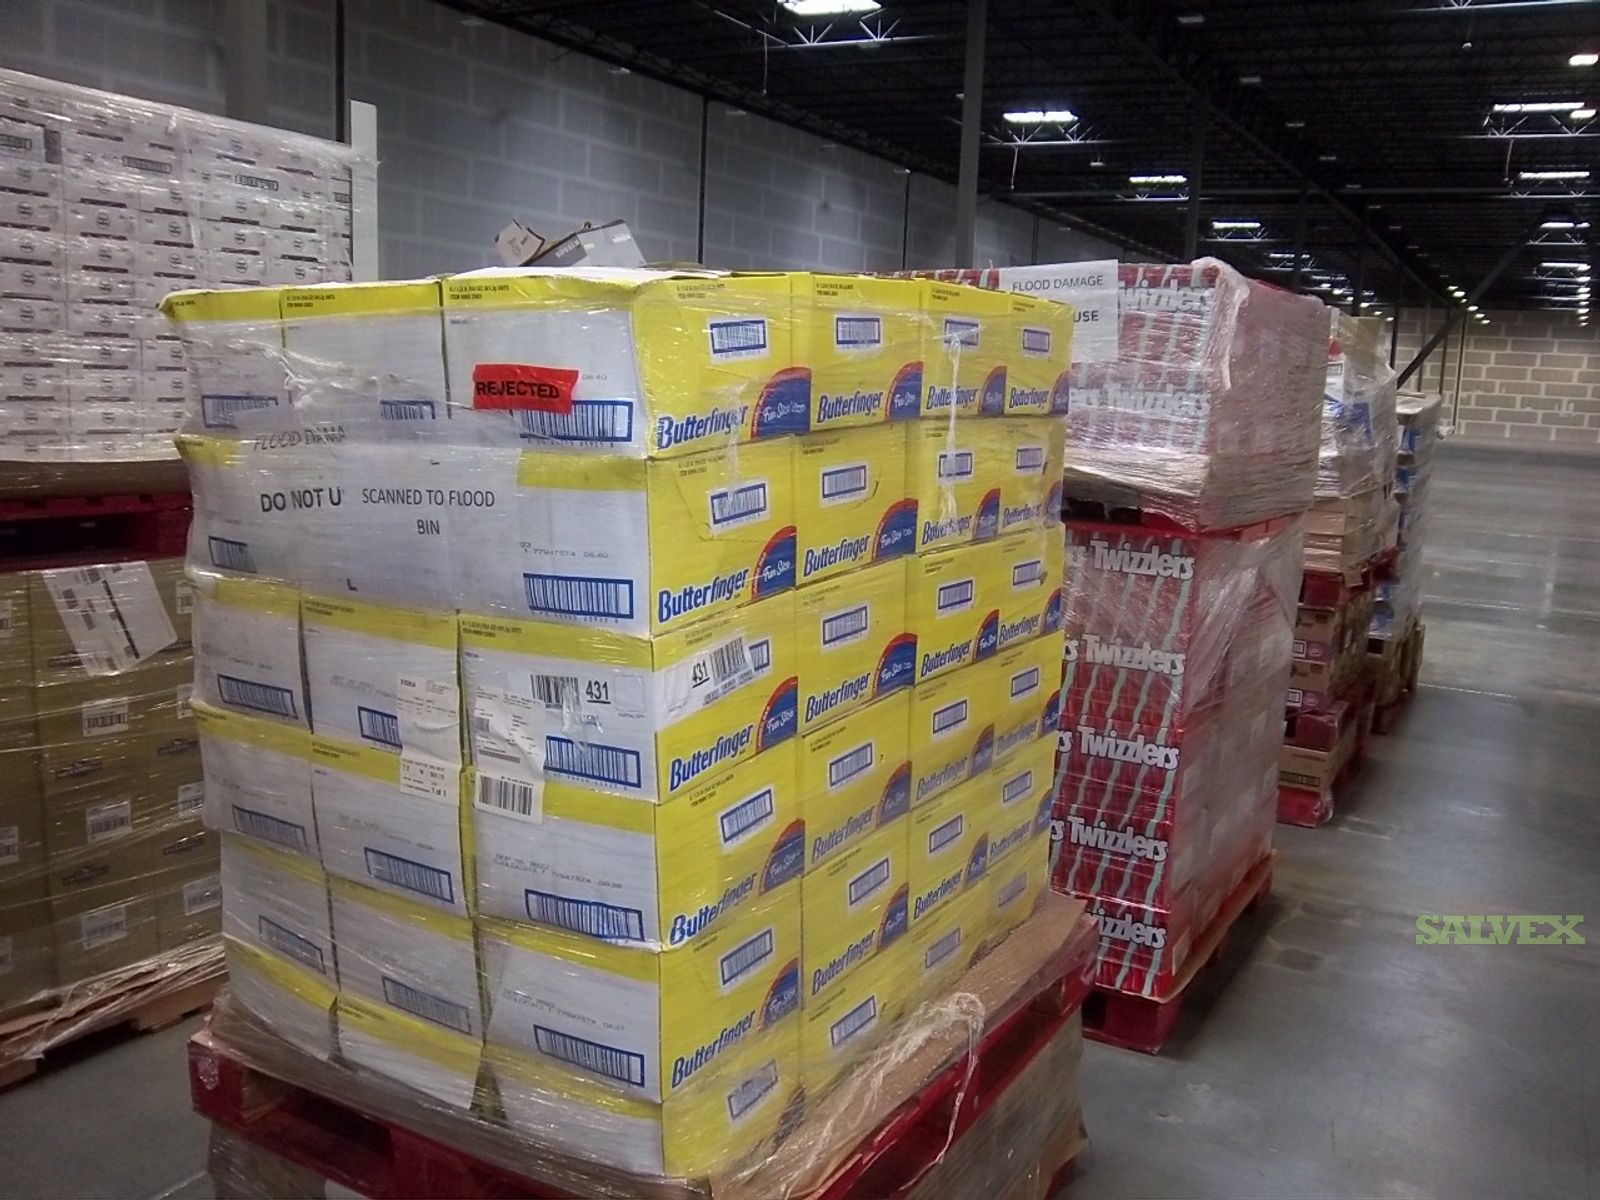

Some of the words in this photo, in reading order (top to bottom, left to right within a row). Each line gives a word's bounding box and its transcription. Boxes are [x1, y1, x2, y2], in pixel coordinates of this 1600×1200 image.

[1012, 279, 1050, 292] FLOOD
[1053, 275, 1104, 289] DAMAGE
[476, 380, 560, 399] REJECTED
[816, 391, 884, 424] Butterfinger
[1009, 386, 1049, 409] Butterfinger
[253, 430, 301, 450] FLOOD
[656, 404, 749, 449] Butterfinger
[260, 493, 286, 512] DO
[291, 488, 324, 509] NOT
[361, 488, 423, 506] SCANNED
[426, 489, 444, 506] TO
[448, 490, 495, 507] FLOOD
[416, 519, 440, 536] BIN
[762, 565, 777, 582] Fun
[803, 534, 870, 577] Butterfinger
[1090, 539, 1196, 580] Twizzlers
[658, 568, 749, 624] Butterfinger
[691, 659, 709, 683] 431
[920, 638, 973, 678] Butterfinger
[1082, 632, 1187, 677] Twizzlers
[586, 681, 609, 700] 431
[804, 672, 871, 723] Butterfinger
[767, 718, 780, 734] Fun
[670, 724, 754, 792] Butterfinger
[1077, 724, 1181, 770] Twizzlers
[811, 804, 875, 864] Butterfinger
[1067, 814, 1169, 862] Twizzlers
[670, 872, 757, 946] Butterfinger
[913, 868, 963, 920] Butterfinger
[1098, 908, 1169, 949] izzlers
[812, 929, 876, 997] Butterfinger
[671, 1010, 756, 1089] Butterfinger
